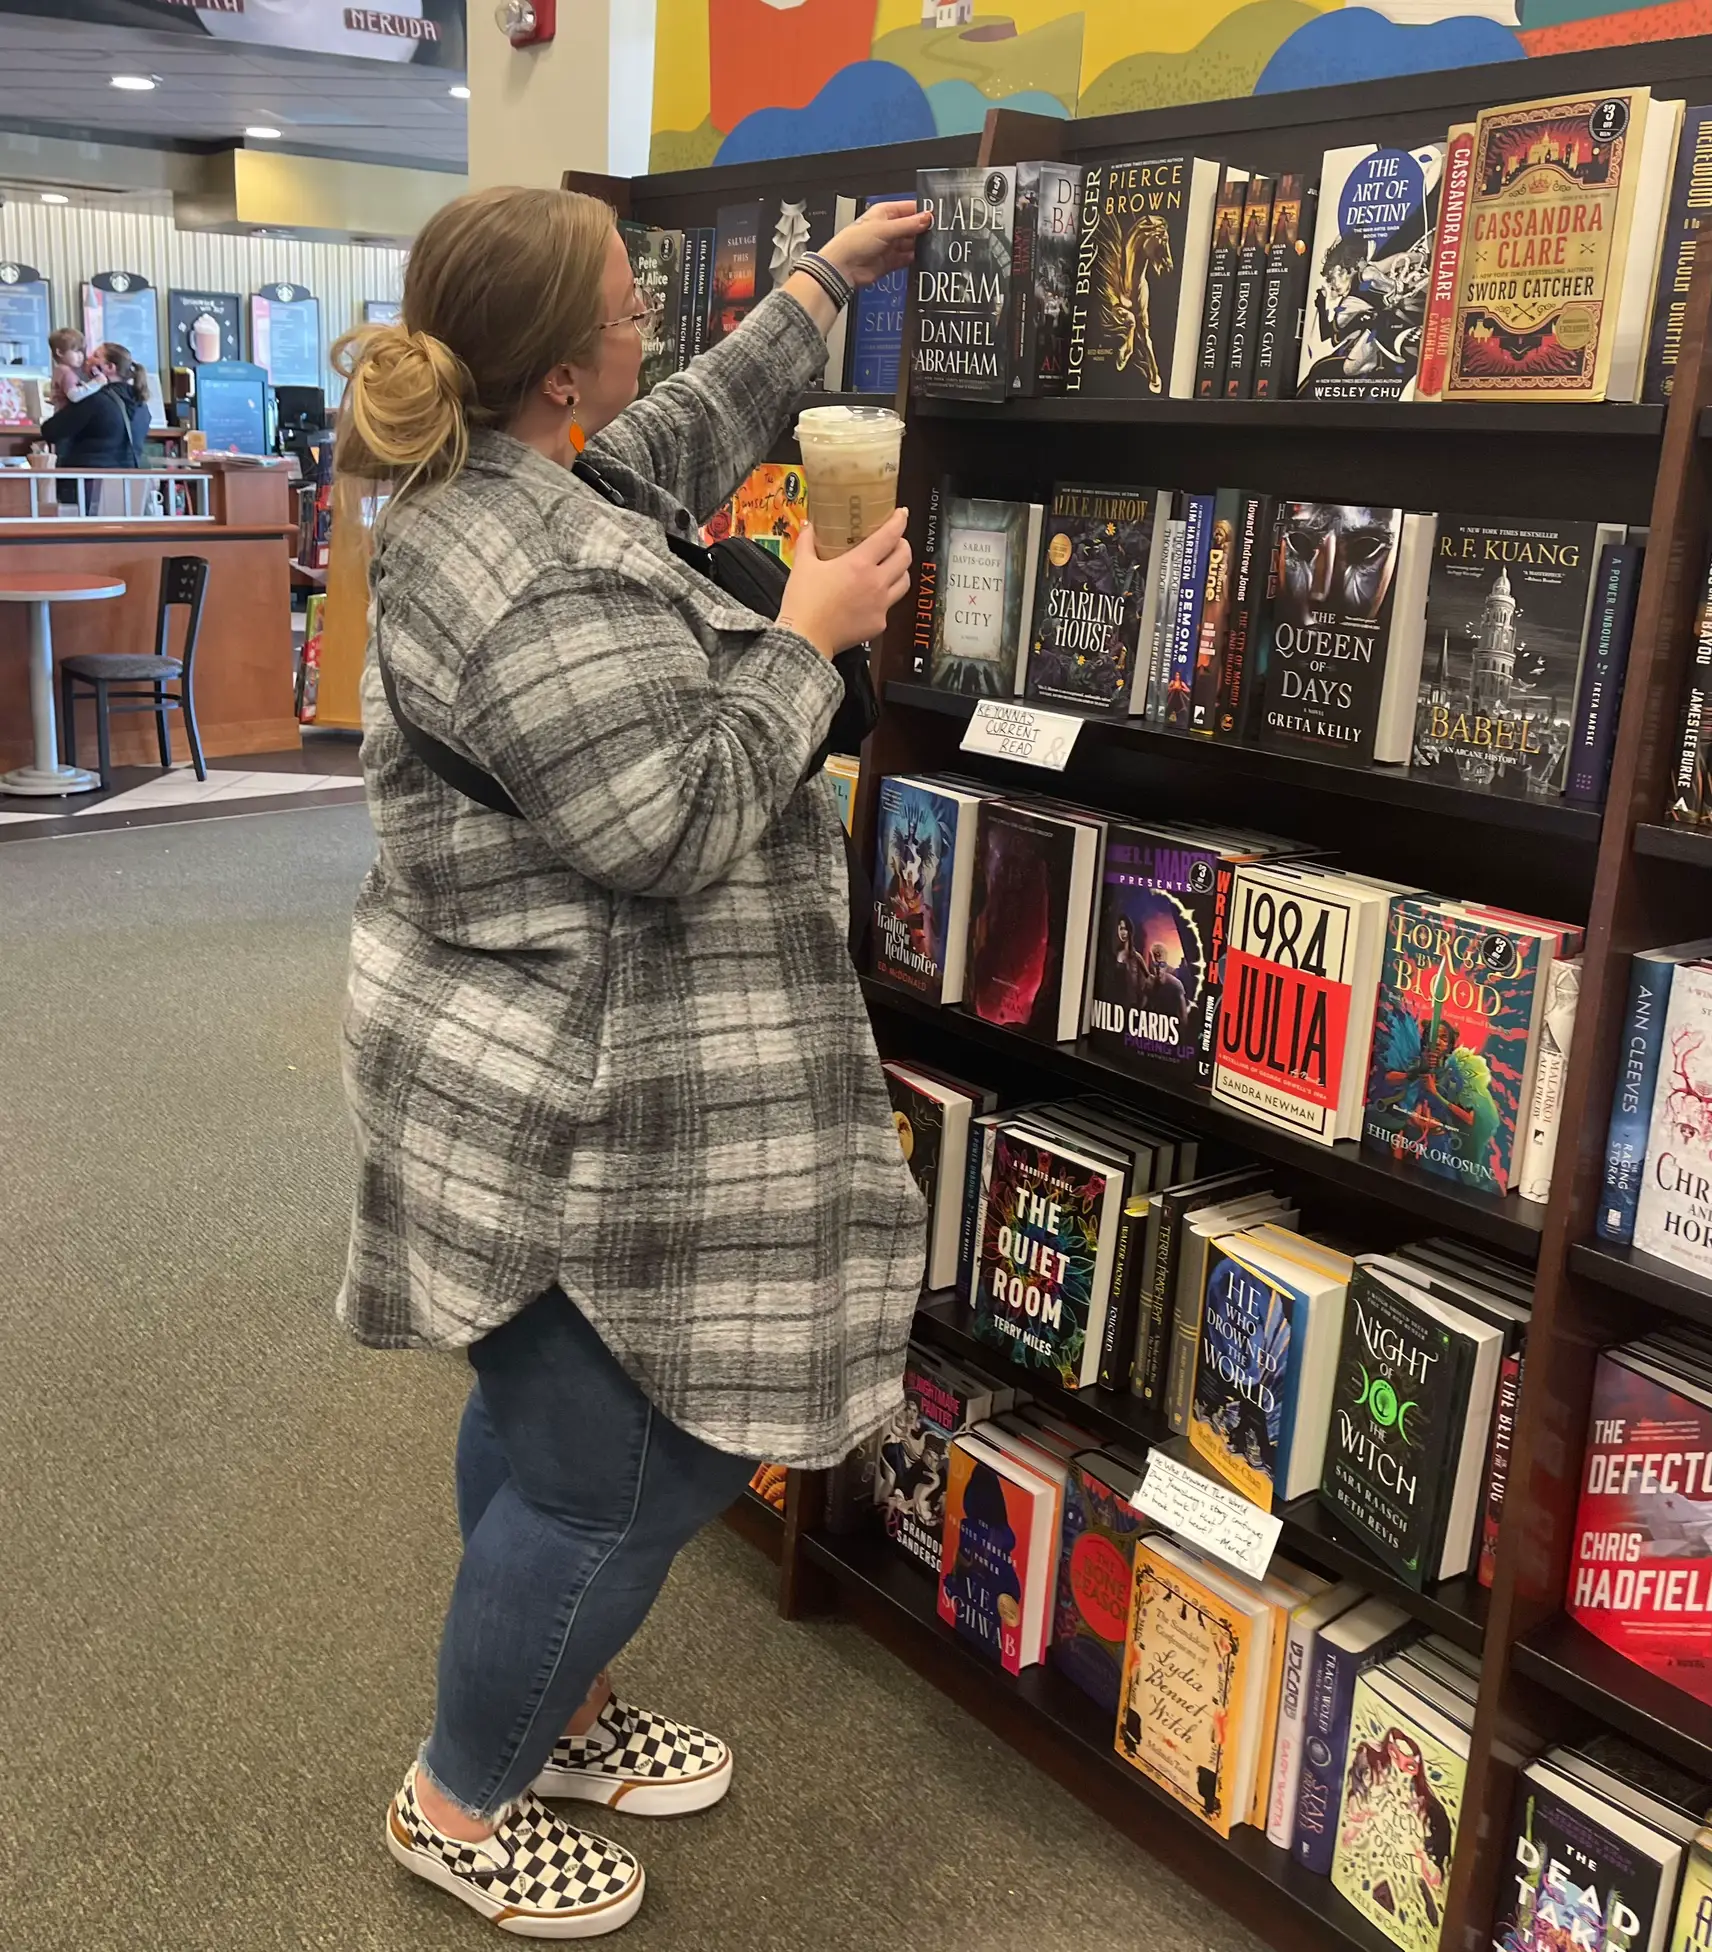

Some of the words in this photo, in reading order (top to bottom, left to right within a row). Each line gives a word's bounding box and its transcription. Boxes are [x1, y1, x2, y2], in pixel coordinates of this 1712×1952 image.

[352, 11, 437, 41] NERUDA
[1603, 104, 1615, 121] $3
[1109, 165, 1183, 191] PIERCE
[1368, 157, 1400, 178] THE
[1105, 190, 1181, 215] BROWN
[1352, 181, 1385, 202] ART
[1385, 180, 1409, 199] OF
[1443, 148, 1470, 244] CASSANDRA
[1075, 167, 1102, 294] BRINGER
[1346, 202, 1411, 225] DESTINY
[1473, 202, 1603, 241] CASSANDRA
[684, 240, 693, 261] LEILA
[699, 240, 707, 261] LEILA
[727, 235, 757, 247] SALVAGE
[733, 253, 749, 263] THIS
[948, 240, 973, 263] OF
[1497, 236, 1568, 269] CLARE
[638, 256, 658, 270] Pete
[646, 273, 669, 286] Alice
[683, 263, 692, 295] SLIMANI
[697, 262, 706, 295] SLIMANI
[1435, 251, 1457, 301] CLARE
[918, 271, 1001, 304] DREAM
[1235, 282, 1250, 329] EBONY
[1265, 280, 1280, 327] EBONY
[1467, 281, 1517, 302] SWORD
[1523, 276, 1594, 298] CATCHER
[1208, 284, 1223, 330] EBONY
[694, 315, 703, 345] WATCH
[920, 319, 994, 346] DANIEL
[1424, 312, 1439, 361] CATCHER
[1436, 317, 1451, 356] SWORD
[693, 345, 701, 355] US
[914, 348, 998, 377] ABRAHAM
[1066, 306, 1088, 391] LIGHT
[1204, 334, 1217, 368] GATE
[1231, 333, 1244, 368] GATE
[1260, 332, 1273, 367] GATE
[1314, 387, 1366, 397] WESLEY
[1370, 387, 1400, 397] CHU
[931, 488, 939, 504] JON
[1188, 502, 1198, 521] KIM
[925, 515, 938, 553] EVANS
[1244, 499, 1259, 536] Howard
[1482, 527, 1497, 535] YORK
[1499, 529, 1519, 537] TIMES
[1519, 530, 1559, 539] BESTSELLER
[952, 554, 1001, 567] DAVIS-GOFF
[963, 542, 991, 553] SARAH
[1182, 526, 1196, 581] HARRISON
[1240, 537, 1254, 574] Andrew
[1439, 536, 1457, 557] R.
[1462, 538, 1477, 558] F.
[1484, 539, 1580, 567] KUANG
[949, 573, 1003, 592] SILENT
[1205, 549, 1224, 601] Dune
[1237, 574, 1249, 601] Jones
[1606, 569, 1621, 604] POWER
[913, 562, 937, 649] EXADELIC
[954, 610, 992, 627] CITY
[1048, 588, 1125, 626] STARLING
[1311, 611, 1336, 624] THE
[1054, 618, 1114, 654] HOUSE
[1178, 588, 1194, 664] DEMONS
[1275, 622, 1375, 663] QUEEN
[1598, 608, 1615, 656] UNBOUND
[1161, 633, 1174, 684] KINGFISHER
[1309, 660, 1327, 672] OF
[1281, 670, 1353, 709] DAYS
[1590, 682, 1602, 709] FREYA
[1686, 687, 1705, 727] JAMES
[985, 719, 1041, 741] CURRENT
[1267, 711, 1311, 733] GRETA
[1317, 721, 1362, 743] KELLY
[1430, 705, 1541, 754] BABEL
[1585, 711, 1598, 747] MARSKE
[1684, 727, 1699, 748] LEE
[1000, 737, 1033, 756] READ
[1455, 748, 1483, 758] ARCANE
[1484, 753, 1518, 765] HISTORY
[1677, 750, 1695, 788] BURKE
[1119, 875, 1192, 893] PRESENTS
[1198, 864, 1207, 878] $3
[874, 900, 908, 944] Traitor
[1208, 870, 1231, 985] WRATH
[1240, 888, 1330, 978] 1984
[884, 931, 938, 978] Redwinter
[1494, 937, 1507, 954] $3
[1393, 958, 1502, 1017] BLOOD
[1090, 1000, 1124, 1033] WILD
[1222, 963, 1327, 1088] JULIA
[1633, 984, 1654, 1031] ANN
[1128, 1008, 1180, 1046] CARDS
[1537, 1050, 1548, 1077] ALEX
[1621, 1036, 1647, 1114] CLEEVES
[1222, 1075, 1262, 1101] SANDRA
[1264, 1093, 1316, 1122] NEWMAN
[1532, 1081, 1546, 1121] PHEBY
[1019, 1162, 1049, 1182] RABBITS
[1051, 1177, 1073, 1193] NOVEL
[1606, 1140, 1622, 1186] STORM
[1618, 1142, 1634, 1190] RAGING
[1016, 1186, 1062, 1236] THE
[997, 1225, 1071, 1285] QUIET
[1118, 1225, 1130, 1261] WALTER
[1112, 1261, 1126, 1298] MOSLEY
[1226, 1270, 1262, 1320] HE
[992, 1266, 1063, 1332] ROOM
[993, 1314, 1023, 1341] TERRY
[1022, 1331, 1052, 1357] MILES
[1105, 1305, 1118, 1352] TOUCHED
[1225, 1302, 1257, 1336] WHO
[1206, 1306, 1278, 1373] DROWNED
[1227, 1343, 1247, 1367] THE
[1203, 1337, 1274, 1414] WORLD
[1378, 1362, 1395, 1380] OF
[1368, 1420, 1387, 1443] THE
[1594, 1420, 1626, 1444] THE
[1181, 1471, 1208, 1491] Drowned
[1211, 1486, 1225, 1500] The
[1228, 1496, 1248, 1515] World
[1335, 1464, 1362, 1495] SARA
[1364, 1489, 1408, 1533] RAASCH
[1337, 1488, 1365, 1520] BETH
[1367, 1516, 1400, 1549] REVIS
[1579, 1531, 1643, 1563] CHRIS
[941, 1585, 1017, 1657] SCHWAB
[1155, 1607, 1170, 1624] The
[1170, 1617, 1211, 1653] Scandalous
[1153, 1649, 1204, 1694] Lydia
[1323, 1653, 1337, 1692] TRACY
[1148, 1693, 1198, 1745] Witch
[1318, 1693, 1332, 1735] WOLFF
[1279, 1738, 1291, 1772] GARY
[1272, 1780, 1286, 1828] WHITTA
[1565, 1843, 1597, 1873] THE
[1515, 1835, 1641, 1936] DEAD
